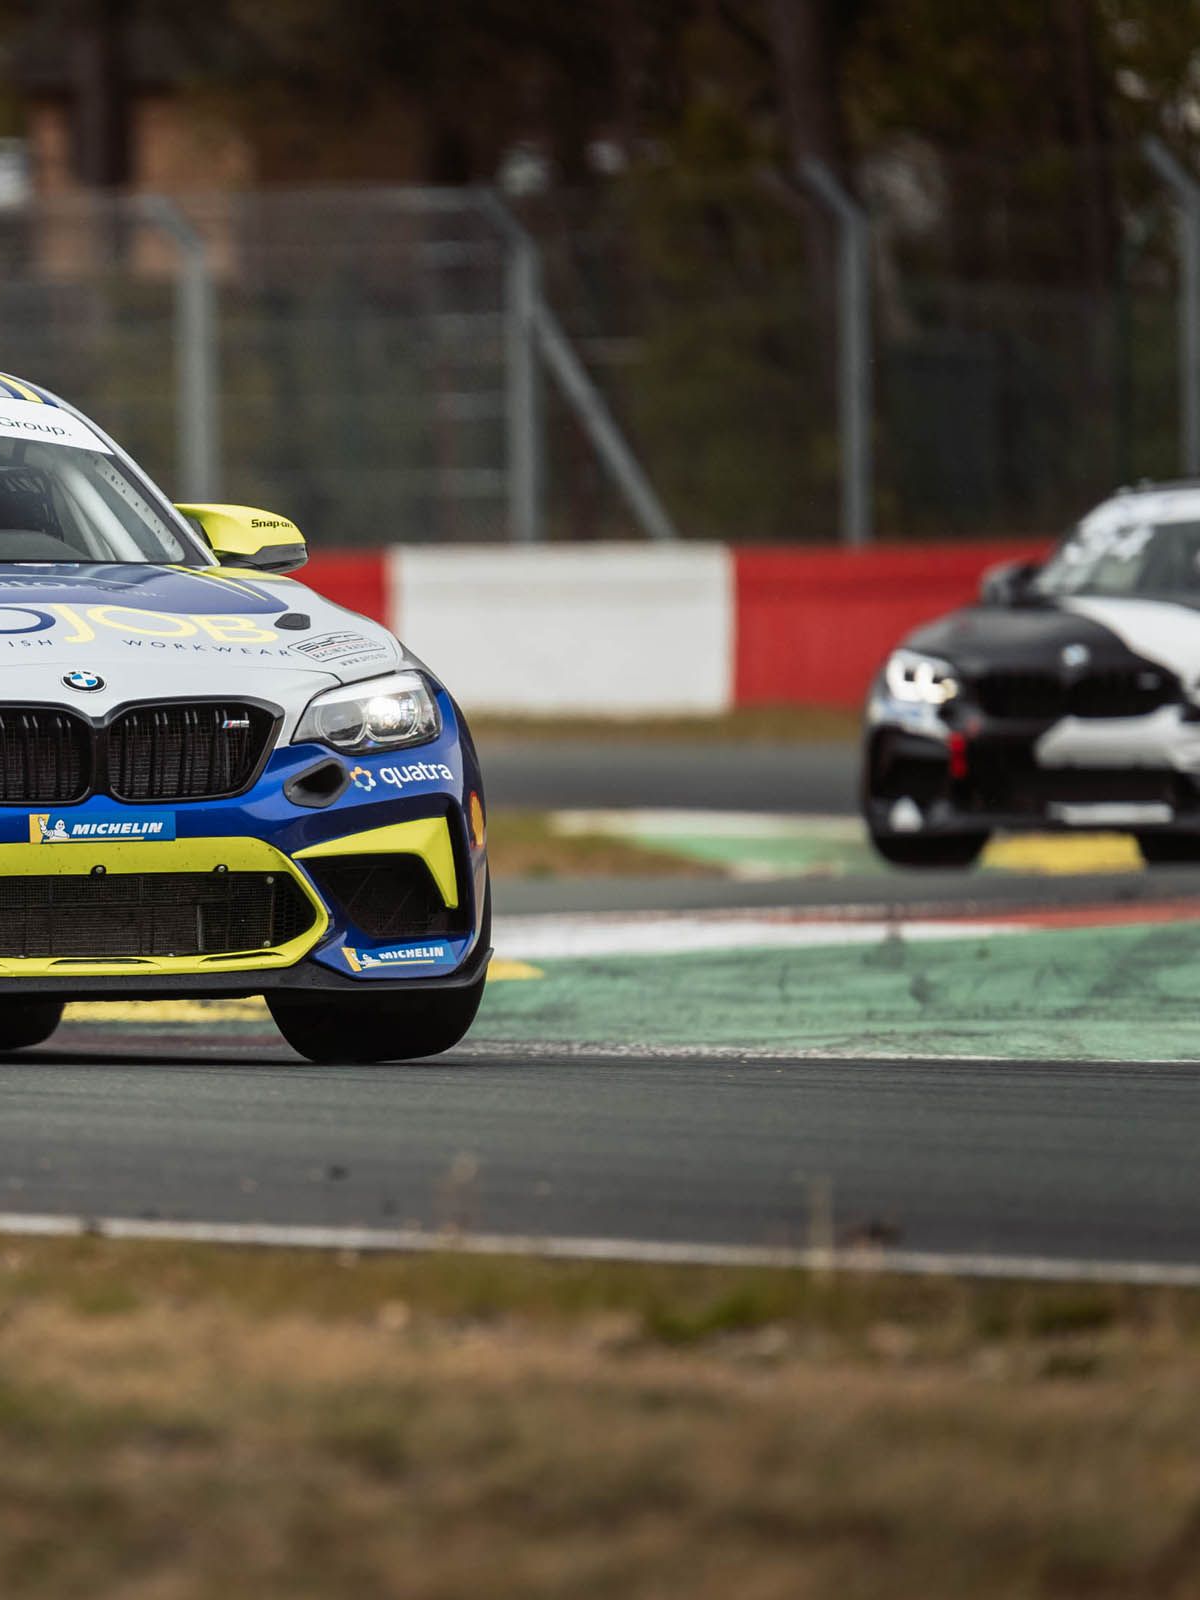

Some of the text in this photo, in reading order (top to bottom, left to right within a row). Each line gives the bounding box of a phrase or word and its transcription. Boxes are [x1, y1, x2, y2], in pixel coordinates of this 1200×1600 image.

[123, 639, 291, 657] WORKWEAR
[380, 761, 454, 789] quatra
[72, 821, 163, 835] MICHELIN
[378, 946, 445, 960] MICHELIN
